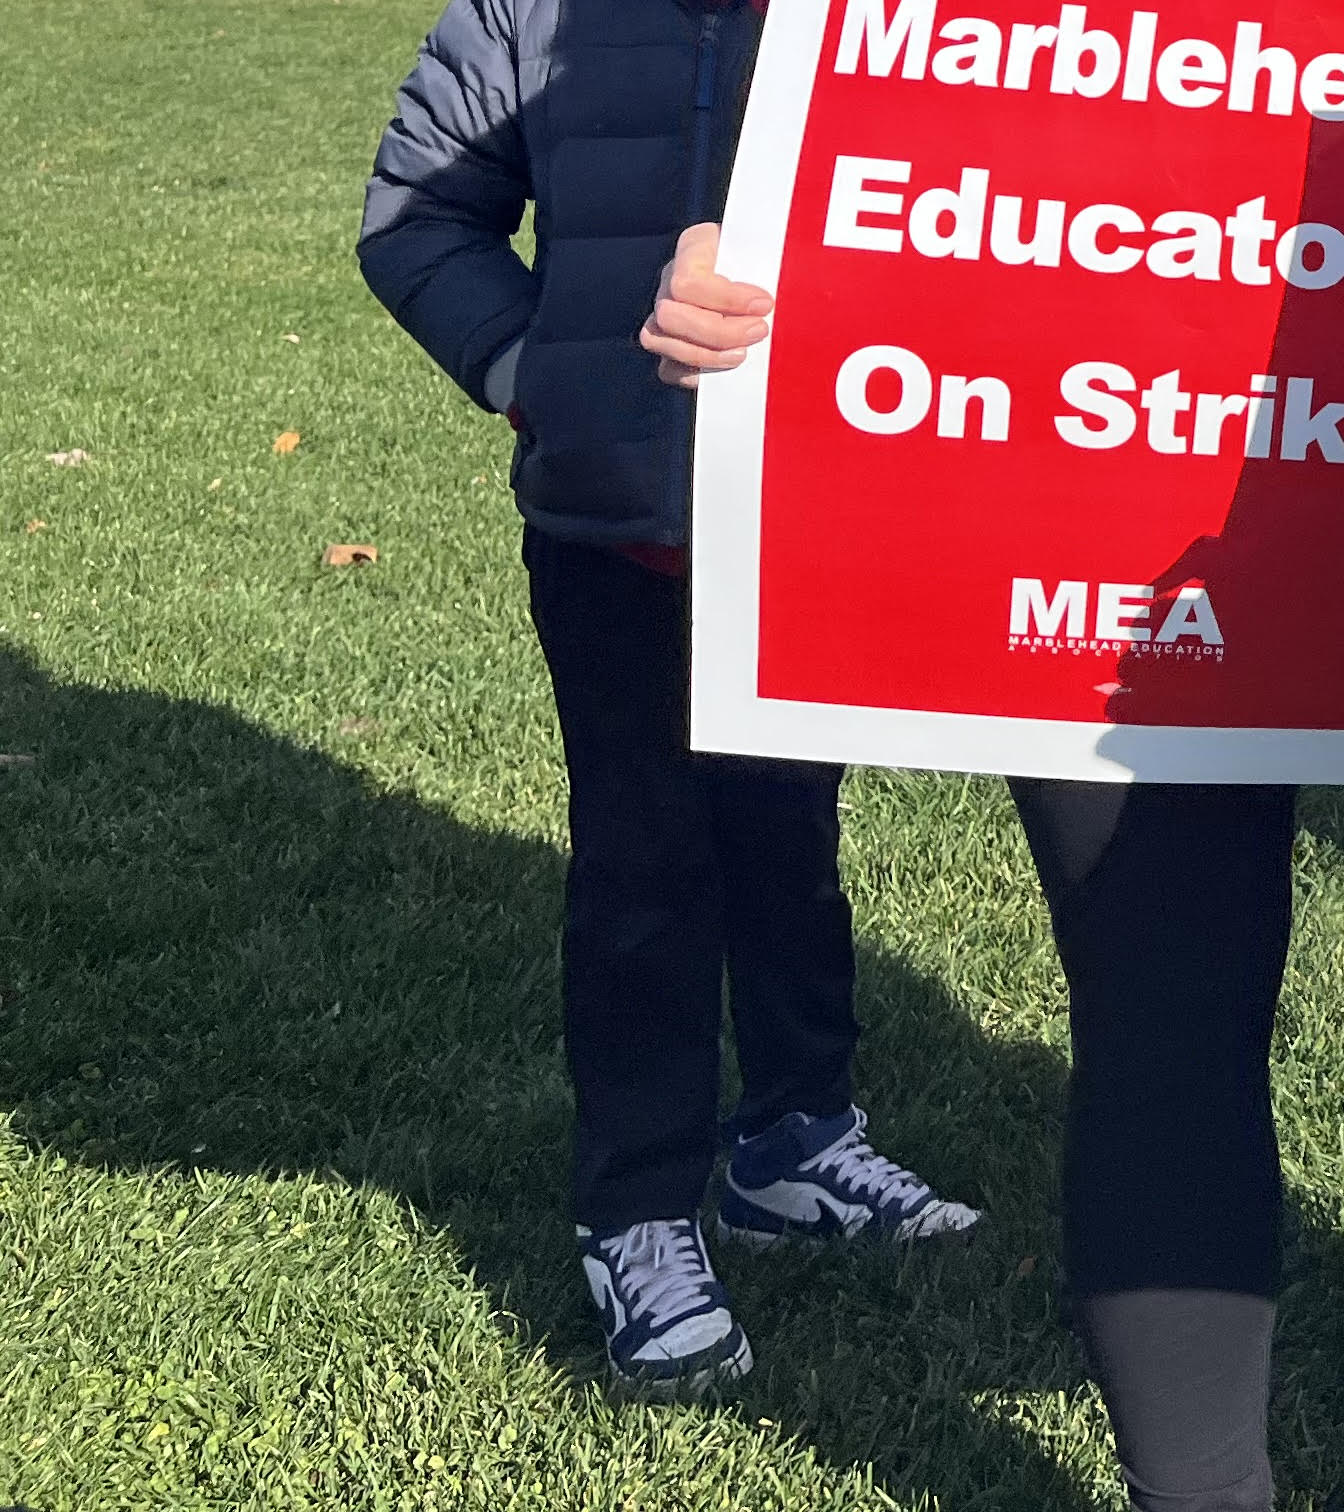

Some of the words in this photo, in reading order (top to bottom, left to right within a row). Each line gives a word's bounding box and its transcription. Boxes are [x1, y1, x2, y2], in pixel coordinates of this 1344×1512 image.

[835, 344, 1012, 442] On
[1009, 577, 1225, 645] MEA
[1008, 636, 1121, 651] MARBLEHEAD
[1131, 642, 1224, 656] EDUCATION
